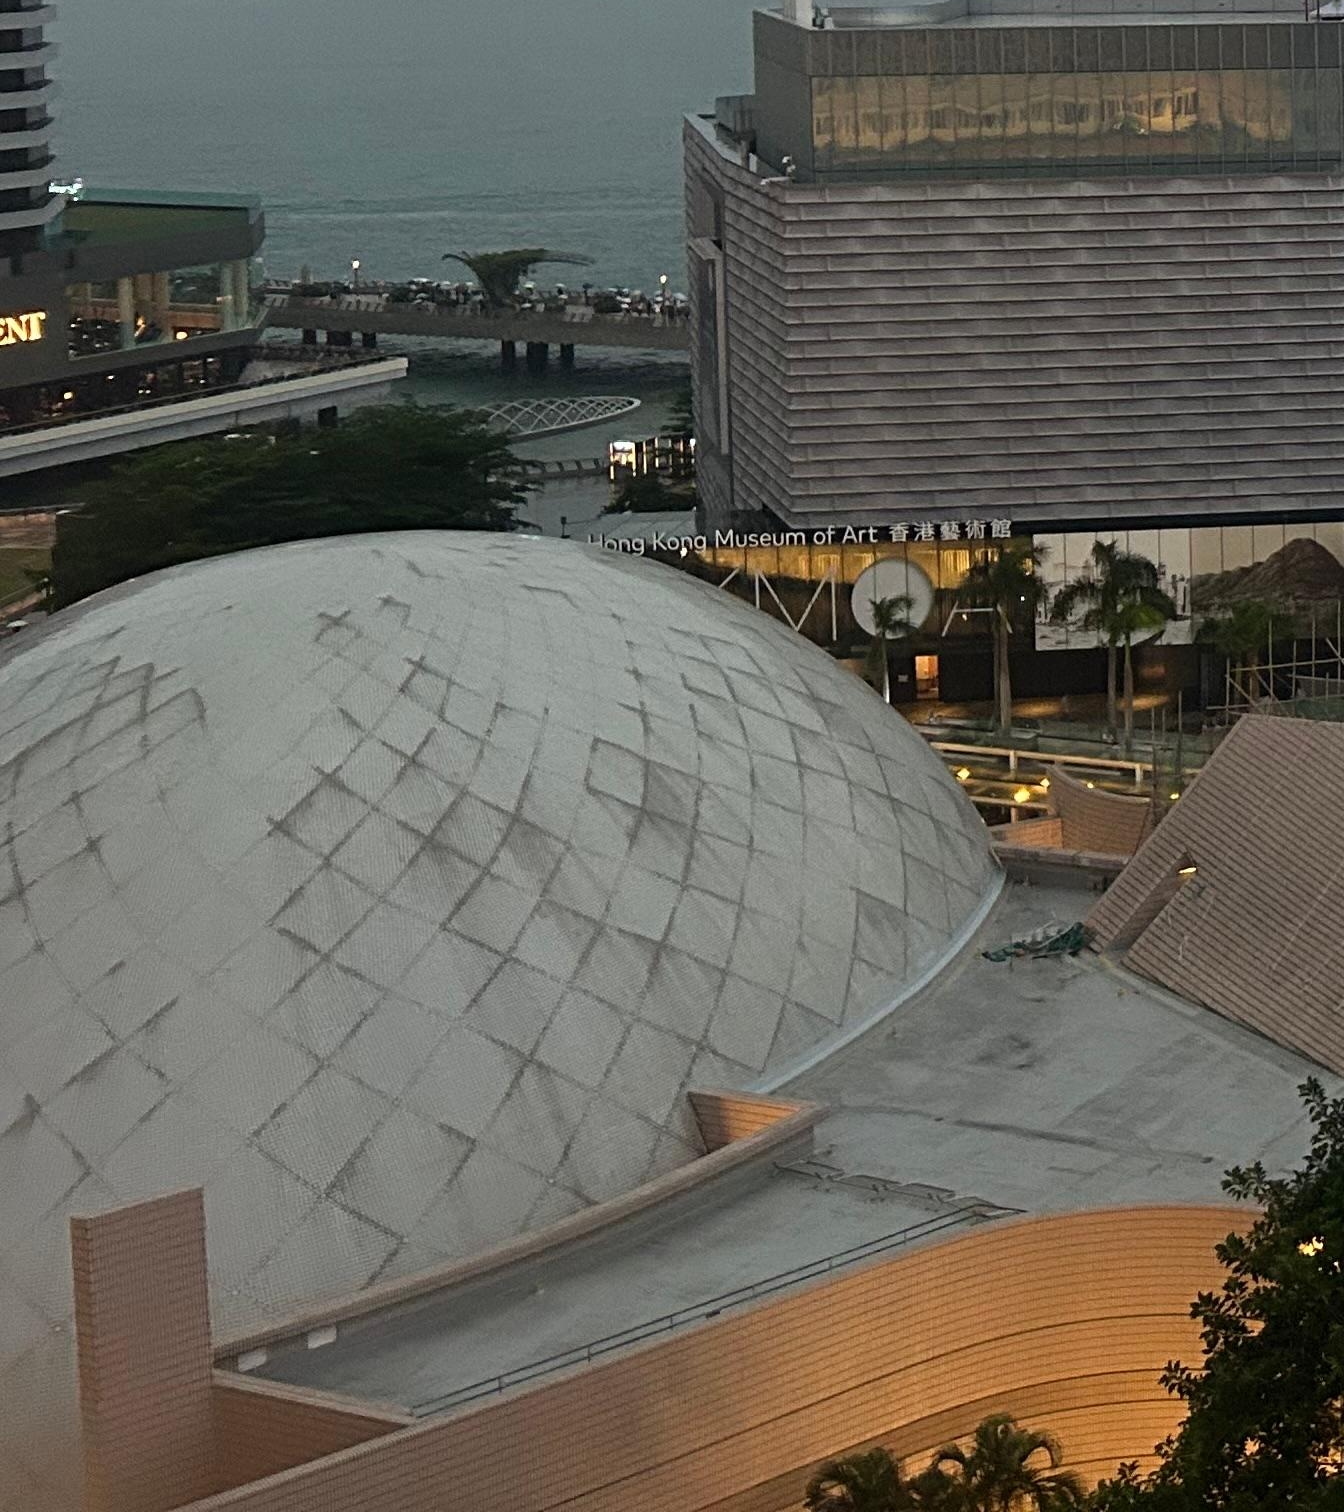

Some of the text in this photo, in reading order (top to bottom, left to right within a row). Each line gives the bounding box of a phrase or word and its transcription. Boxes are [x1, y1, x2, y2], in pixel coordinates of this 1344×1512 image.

[588, 518, 1013, 557] Hong Kong Museum of Art 香港藝術館
